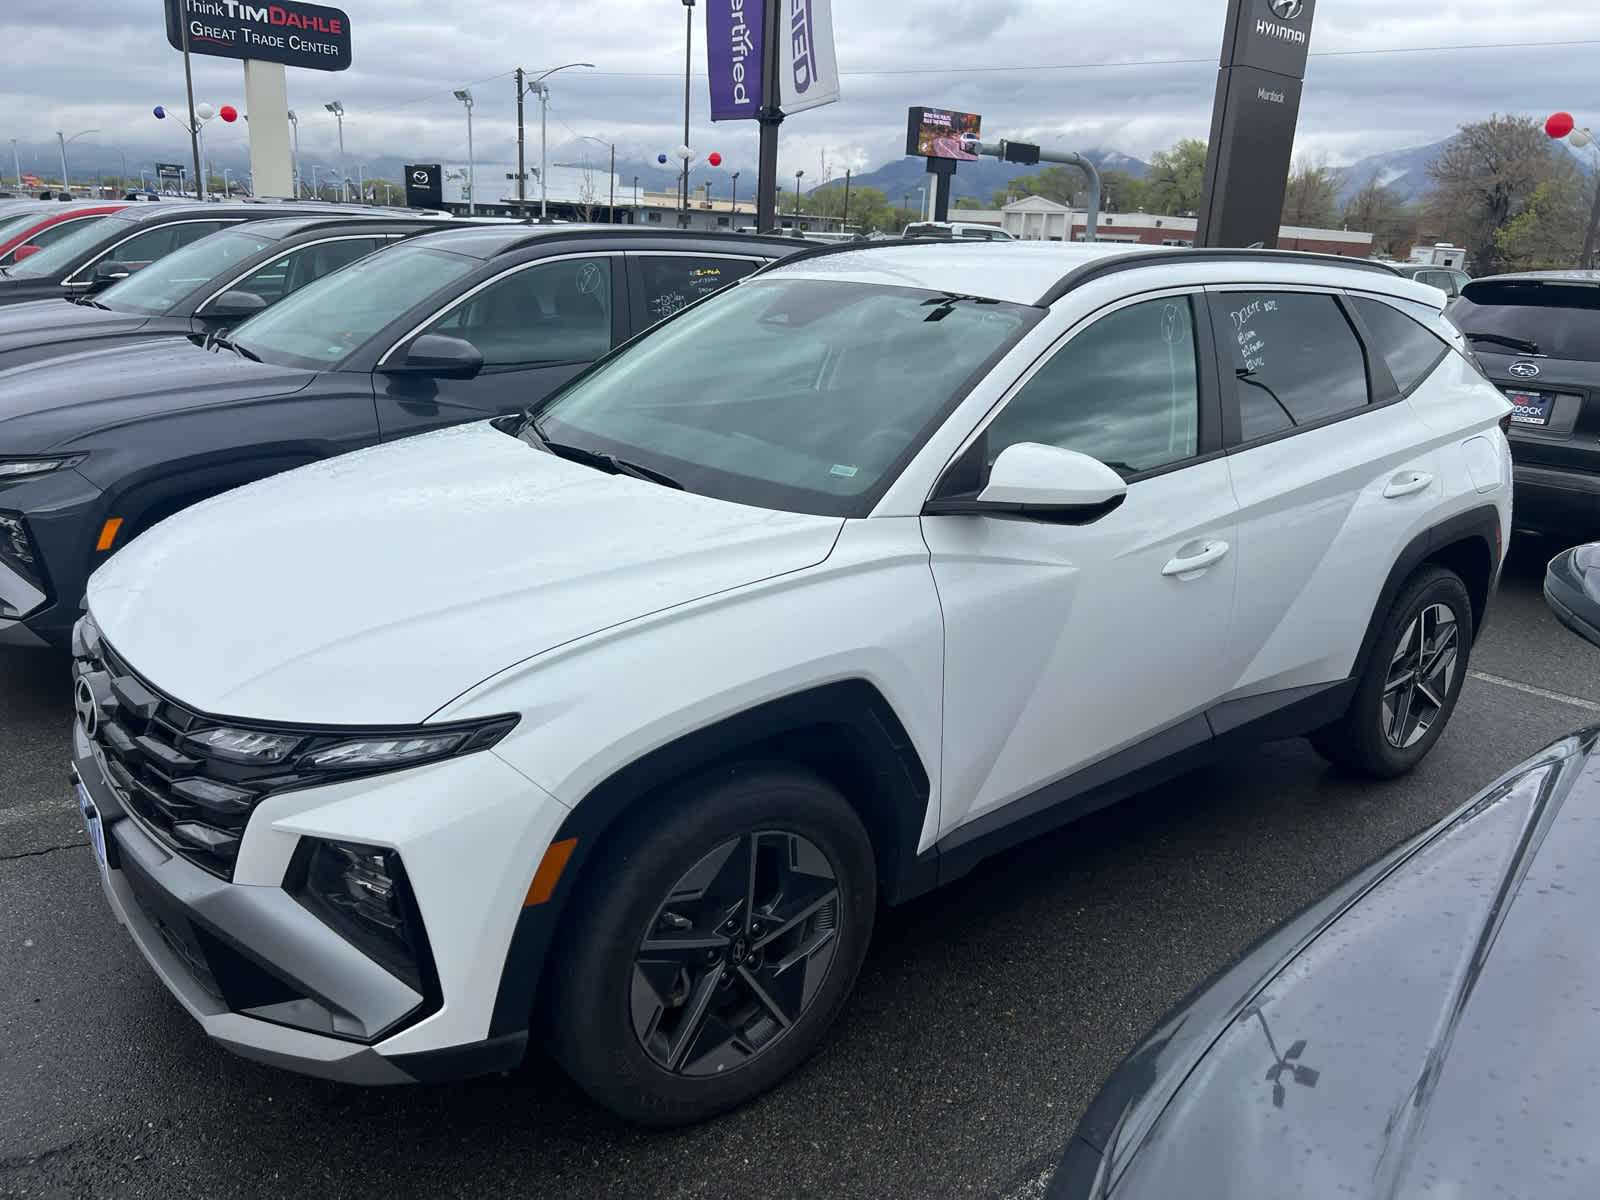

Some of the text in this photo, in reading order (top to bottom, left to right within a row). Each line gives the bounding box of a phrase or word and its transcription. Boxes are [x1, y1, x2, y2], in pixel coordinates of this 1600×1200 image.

[190, 21, 339, 56] GREAT TRADE CENTER
[1256, 20, 1305, 43] HYUNDAI
